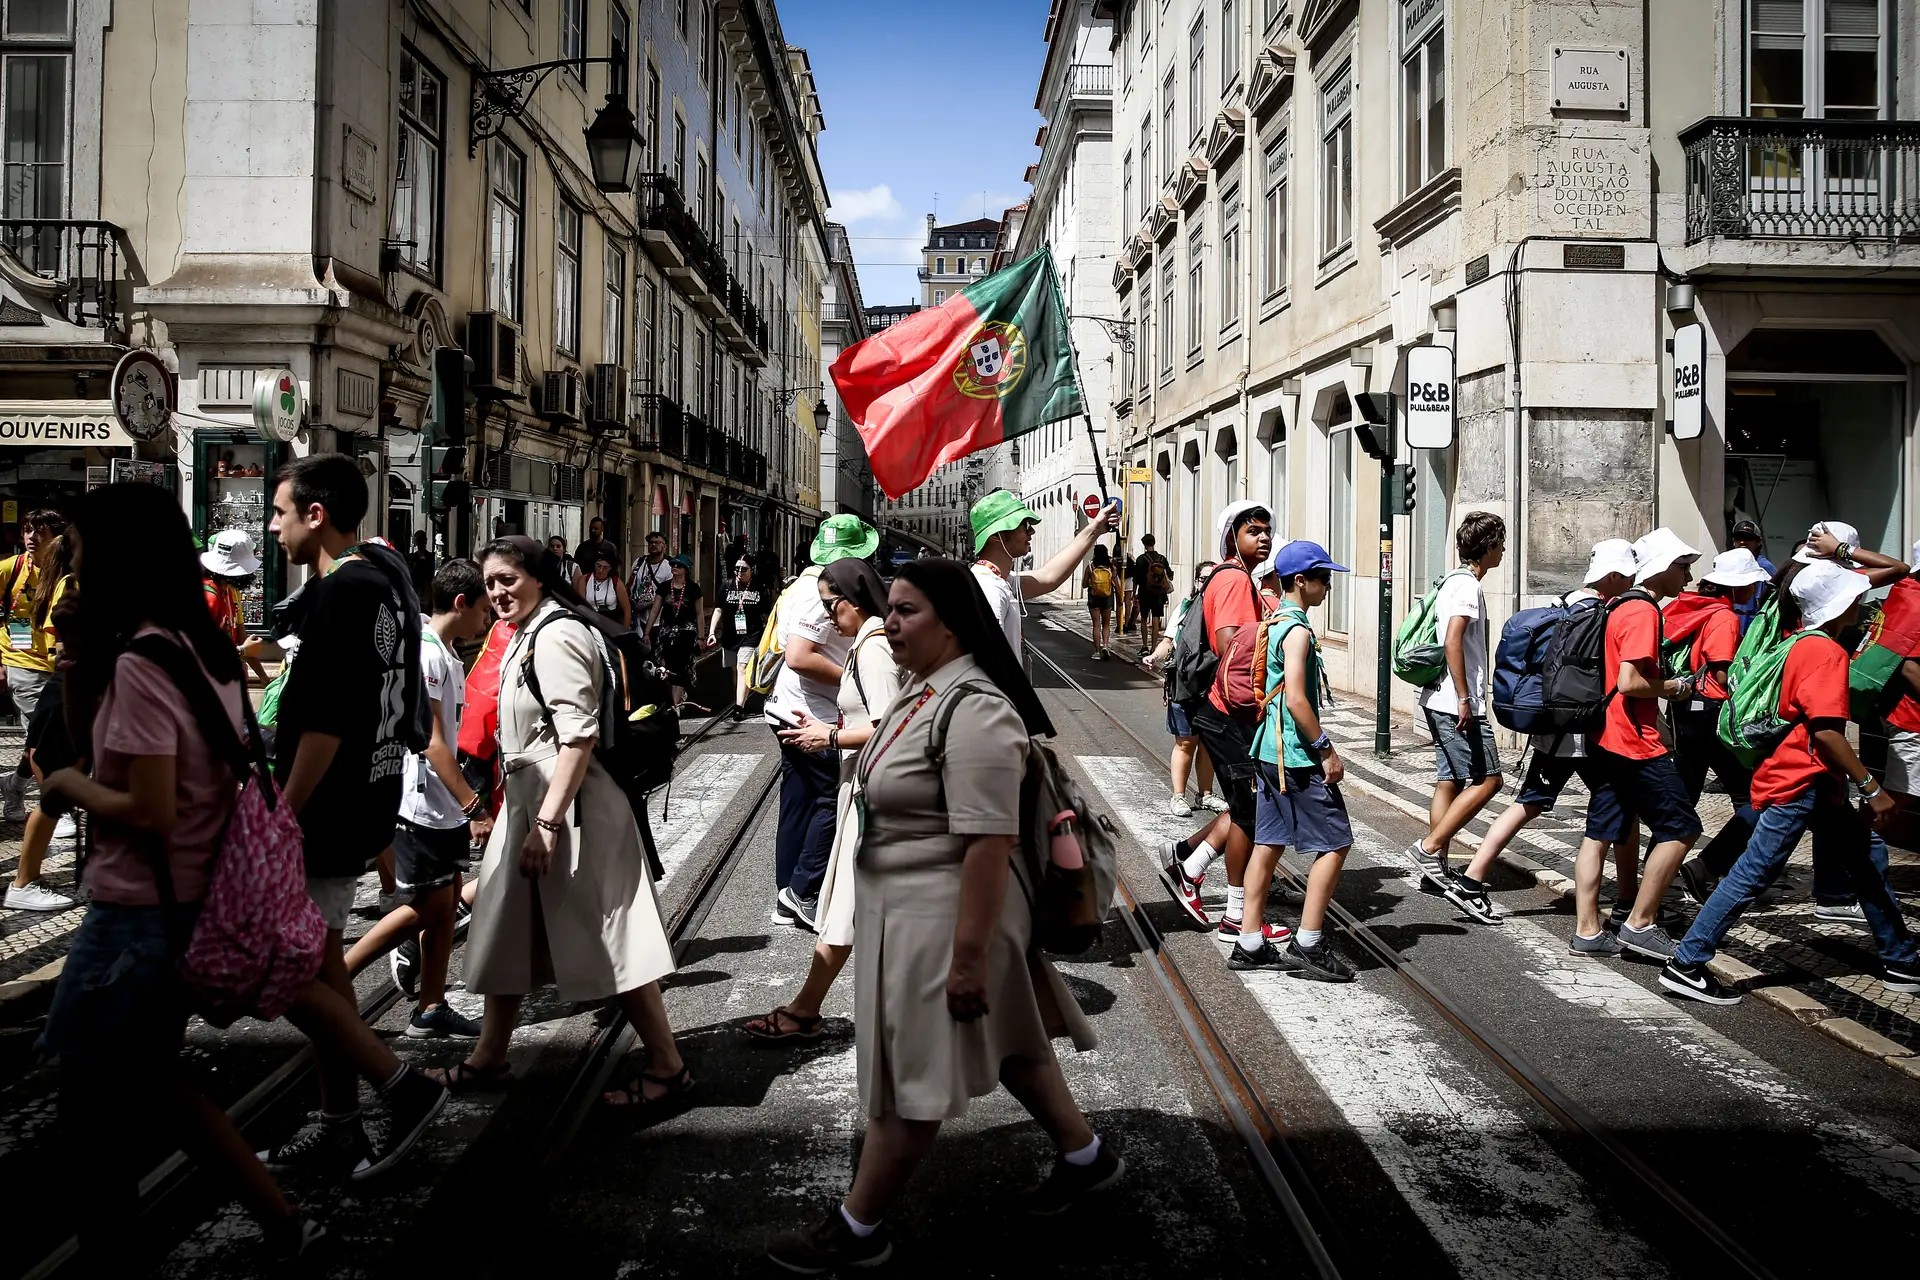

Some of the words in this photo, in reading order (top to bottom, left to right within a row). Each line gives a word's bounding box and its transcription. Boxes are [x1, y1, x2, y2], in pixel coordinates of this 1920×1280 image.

[1580, 66, 1599, 75] RUA
[1568, 81, 1610, 91] AUGUSTA
[1553, 203, 1627, 216] OCCIDEN
[1675, 364, 1700, 389] P&B
[1410, 382, 1450, 402] P&B
[1410, 404, 1450, 412] PULL&BEAR
